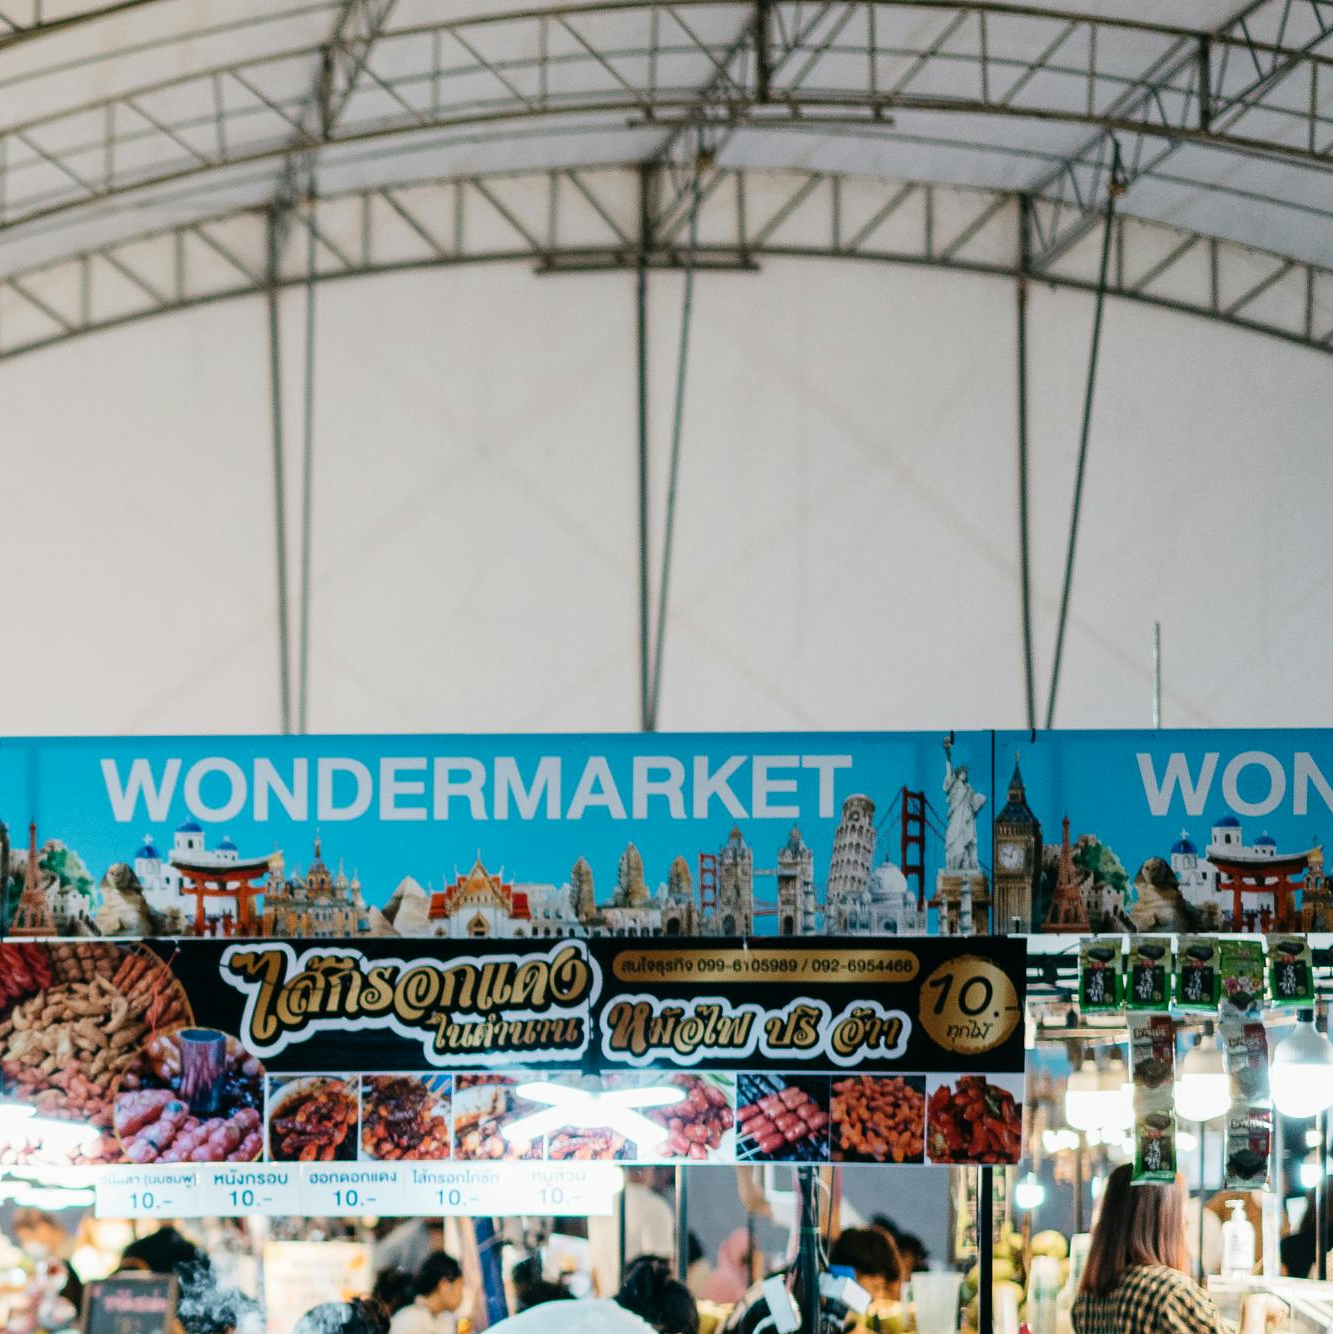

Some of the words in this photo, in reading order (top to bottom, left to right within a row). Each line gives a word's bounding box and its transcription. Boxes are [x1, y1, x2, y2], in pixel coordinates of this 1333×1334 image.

[101, 755, 853, 822] WONDERMARKET
[231, 946, 587, 1040] ไส้กรอกแดง
[426, 1011, 578, 1050] ในตำนาน
[230, 1190, 272, 1207] 10.-
[333, 1190, 376, 1207] 10.-
